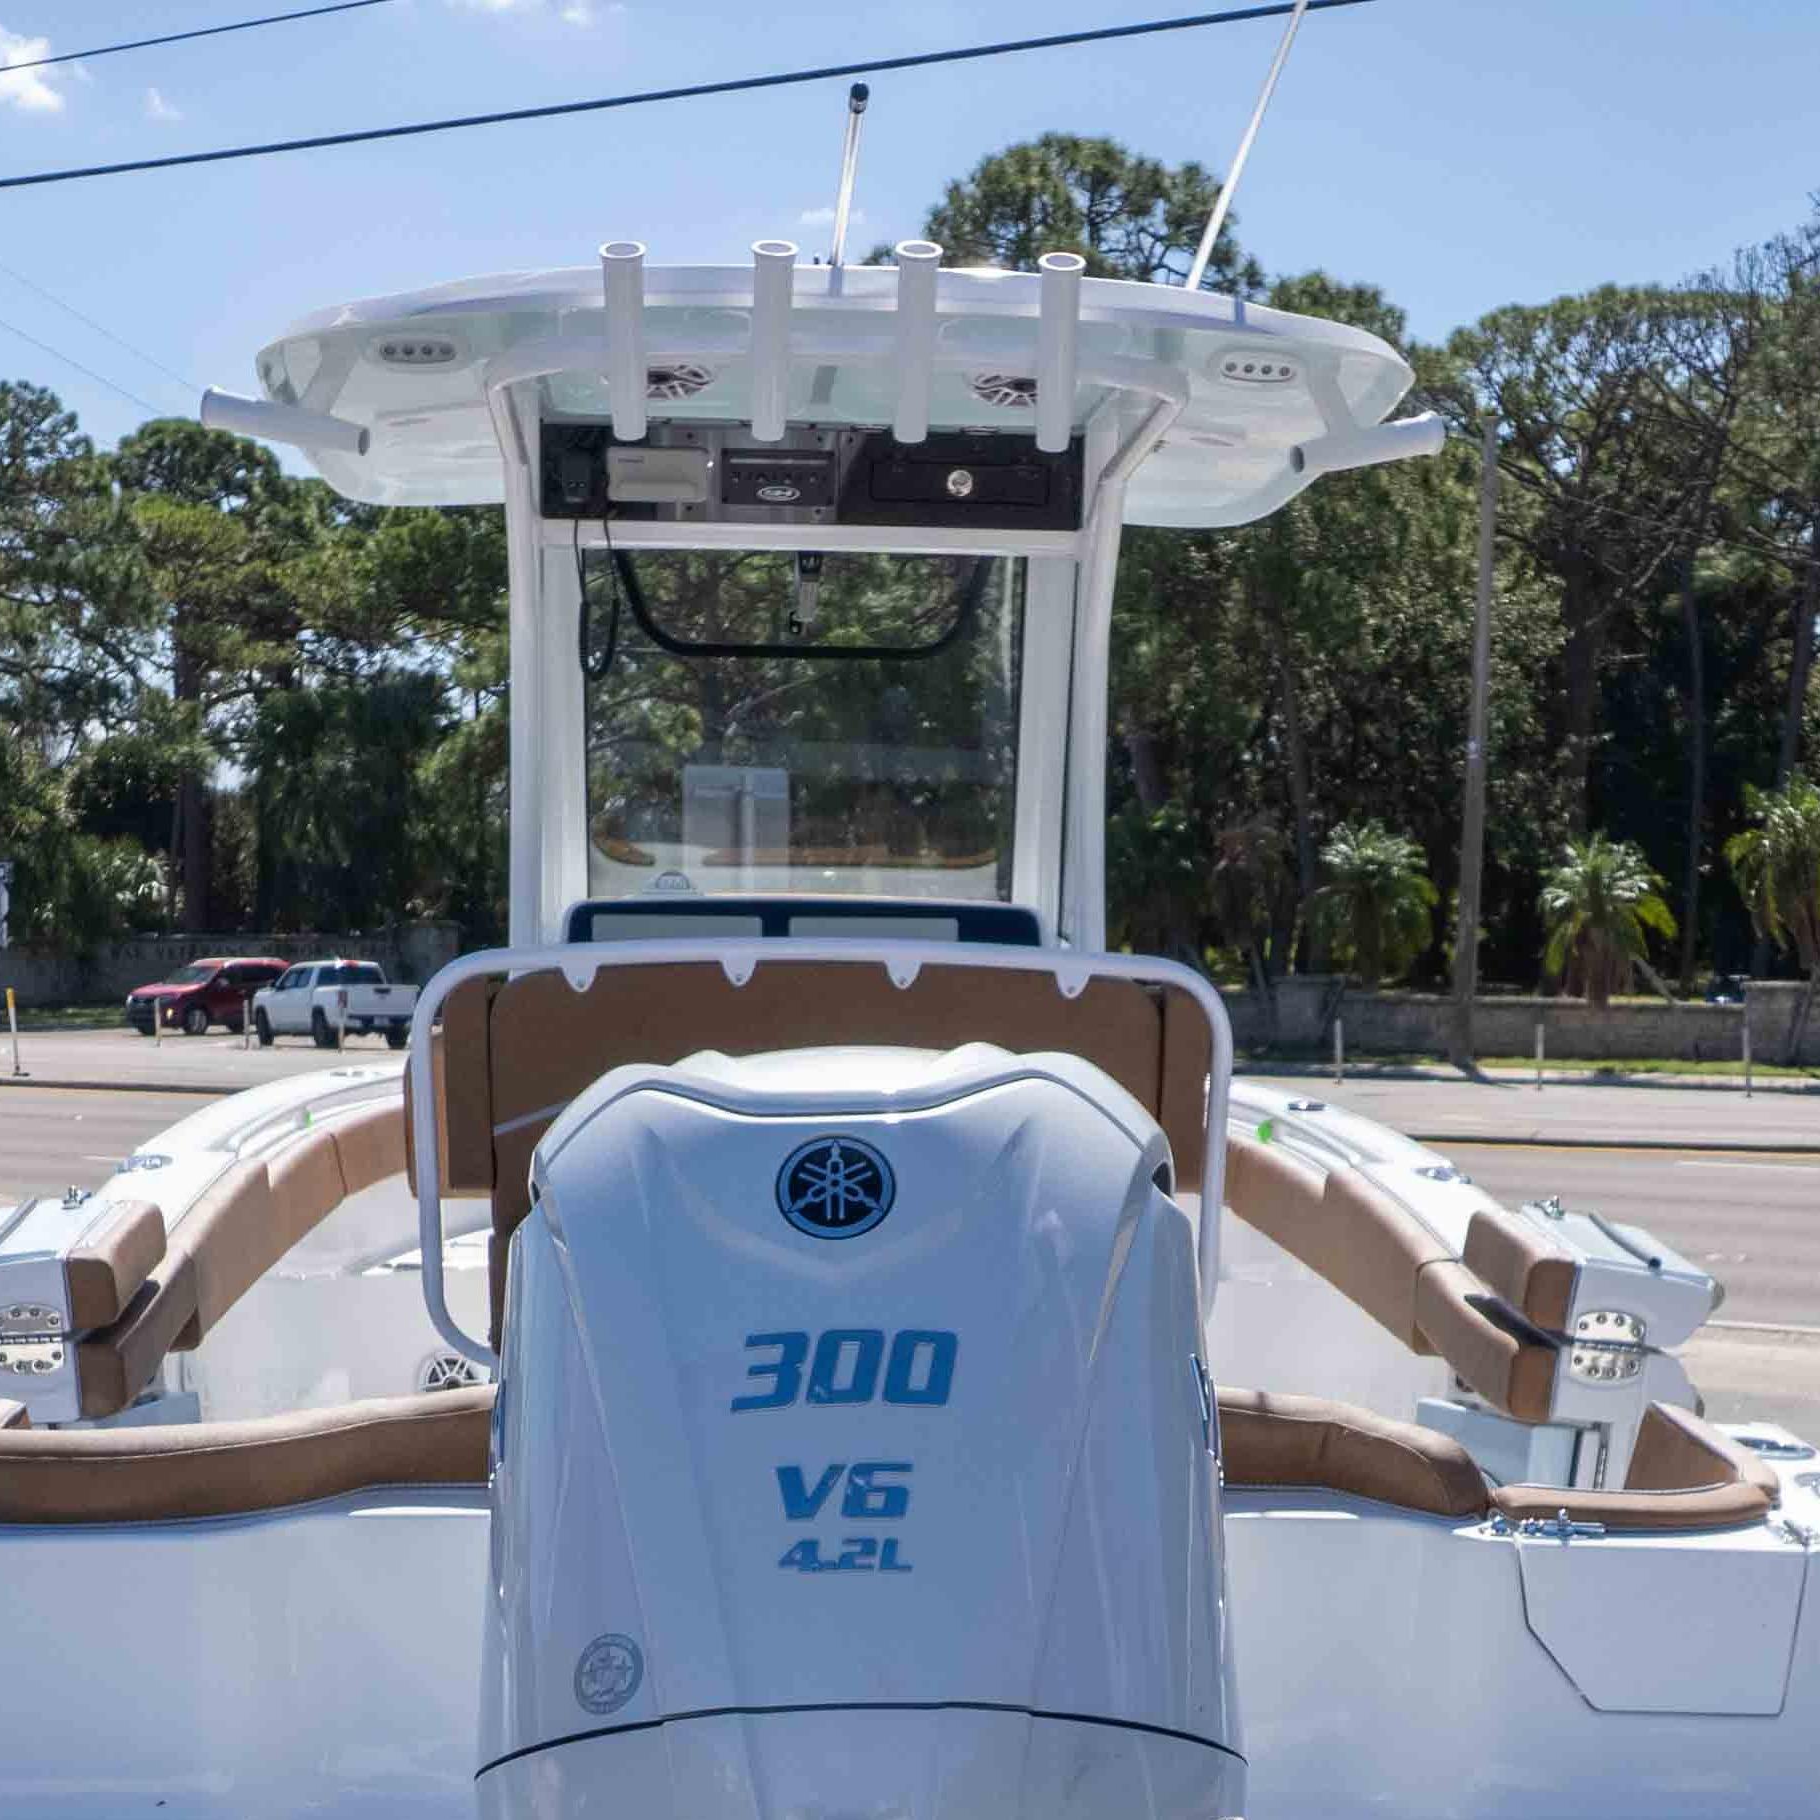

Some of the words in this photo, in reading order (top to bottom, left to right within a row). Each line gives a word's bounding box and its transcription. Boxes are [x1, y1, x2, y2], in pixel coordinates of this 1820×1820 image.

[730, 1329, 958, 1412] 300
[776, 1462, 914, 1520] V6
[779, 1537, 914, 1573] 4.2L
